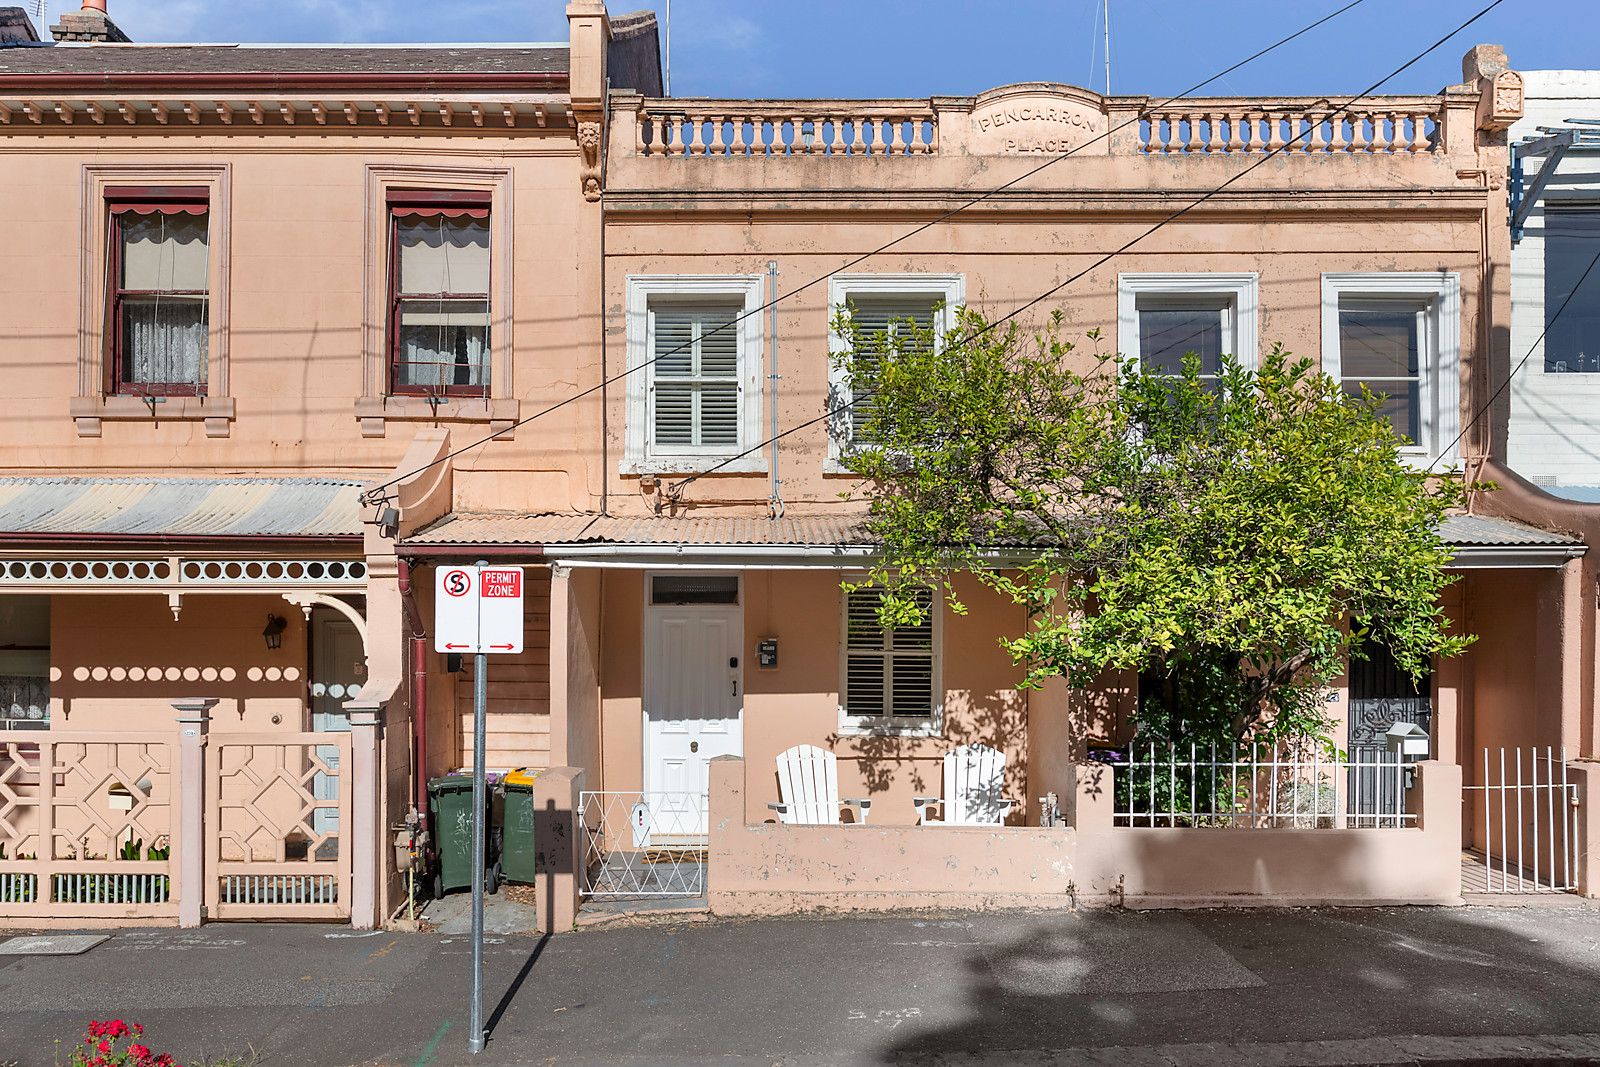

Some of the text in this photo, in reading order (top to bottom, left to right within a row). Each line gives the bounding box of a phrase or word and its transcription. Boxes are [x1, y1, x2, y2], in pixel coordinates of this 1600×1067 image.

[978, 107, 1096, 133] PENCARRON
[1004, 138, 1069, 152] PLACE
[485, 572, 517, 584] PERMIT
[487, 585, 515, 597] ZONE
